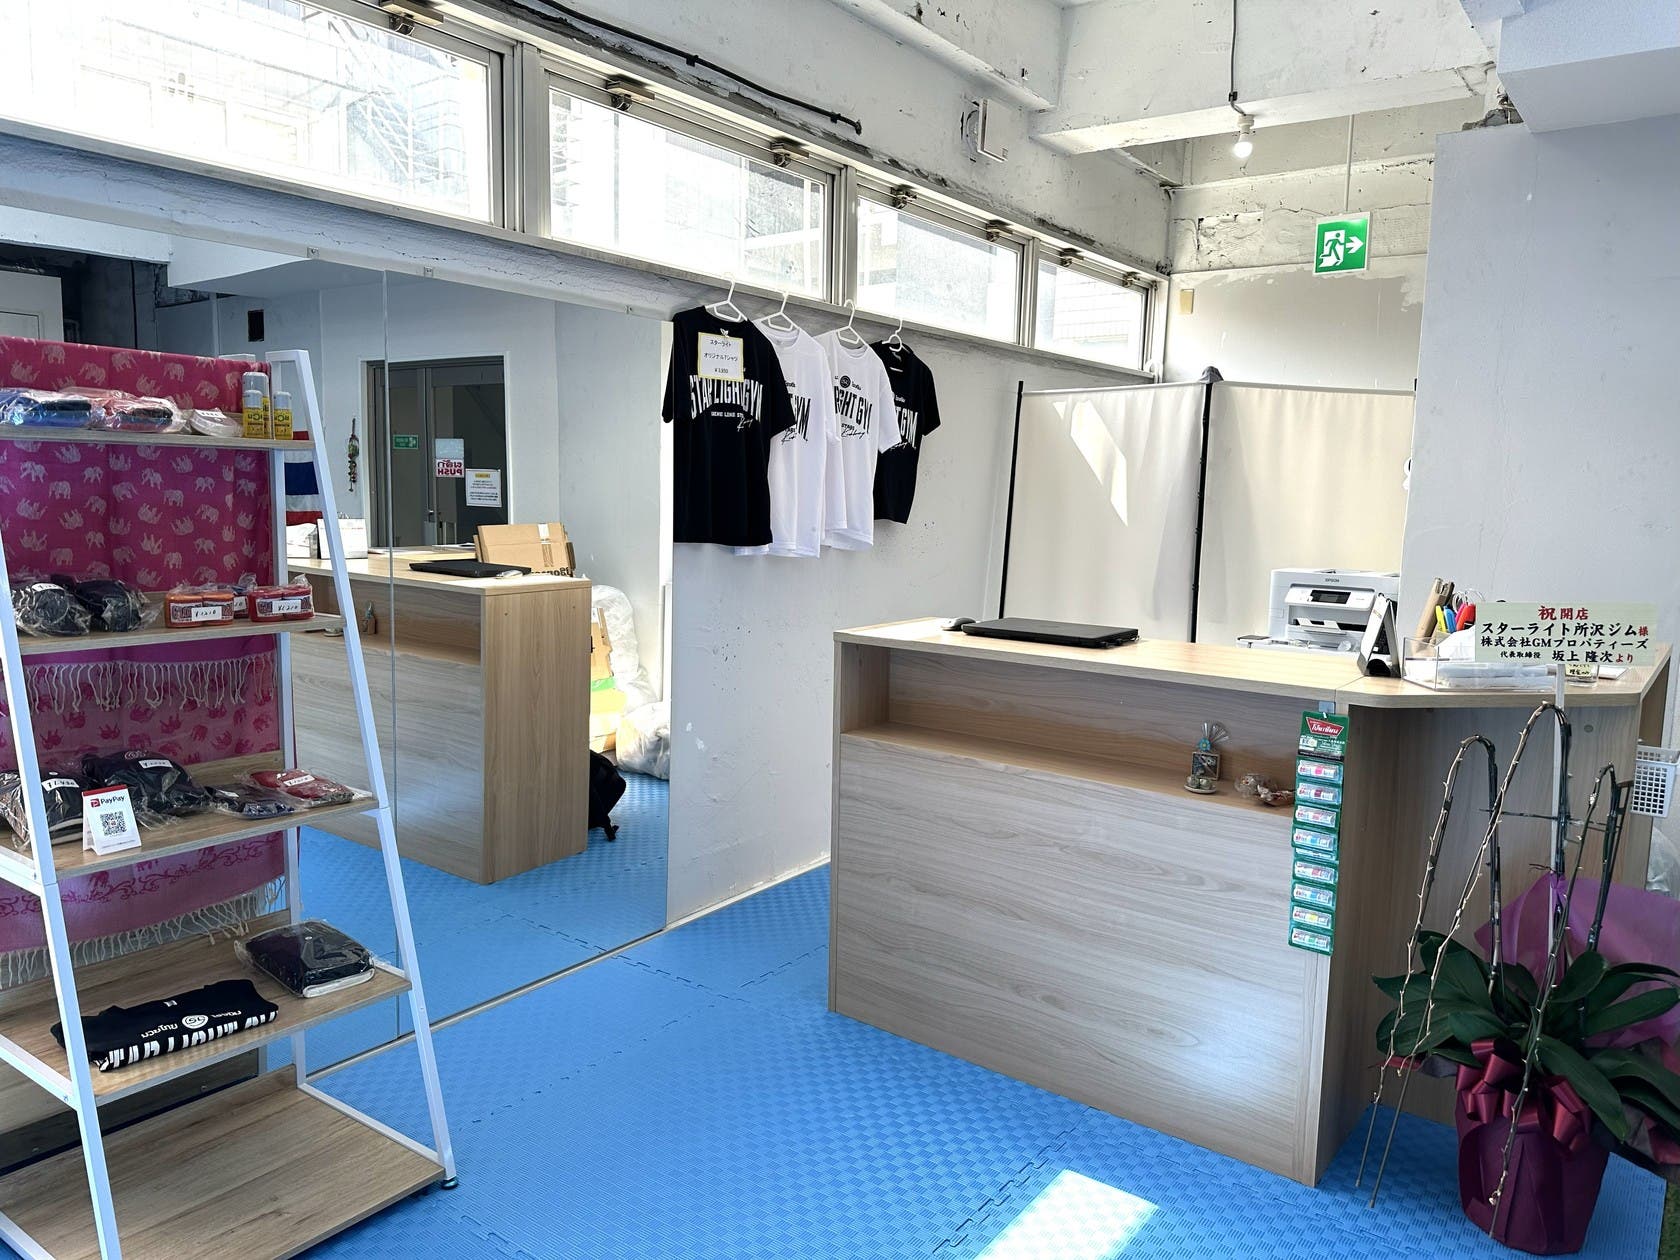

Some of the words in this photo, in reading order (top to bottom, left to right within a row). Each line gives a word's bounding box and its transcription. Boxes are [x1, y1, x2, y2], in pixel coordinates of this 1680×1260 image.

[689, 374, 744, 420] STARLIGH
[1538, 606, 1589, 621] 祝開店
[1480, 621, 1649, 638] スターライト所沢ジム様
[101, 796, 125, 805] PayPay
